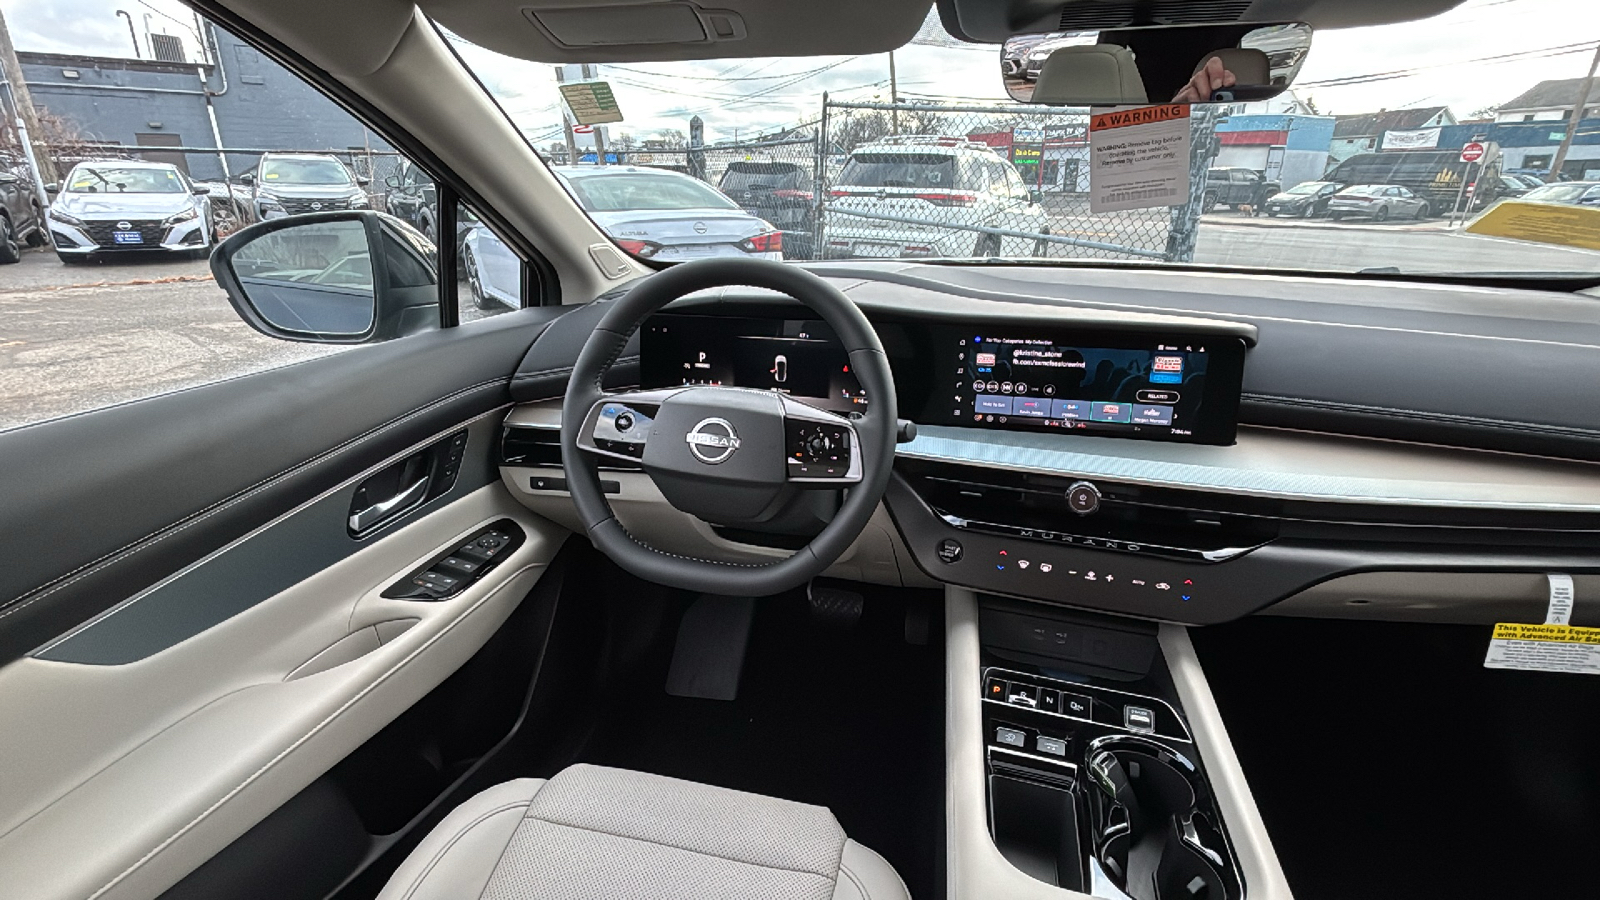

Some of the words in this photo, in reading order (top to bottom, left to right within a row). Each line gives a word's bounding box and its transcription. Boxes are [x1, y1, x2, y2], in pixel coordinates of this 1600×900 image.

[1110, 106, 1181, 125] WARNING
[1163, 136, 1182, 144] before
[699, 351, 706, 362] P
[689, 434, 740, 447] NISSAN
[1020, 530, 1141, 551] MURANO
[1497, 624, 1518, 632] This
[1520, 626, 1555, 634] Vehicle
[1519, 632, 1566, 641] Advanced
[993, 685, 1000, 693] P
[1045, 696, 1054, 704] N
